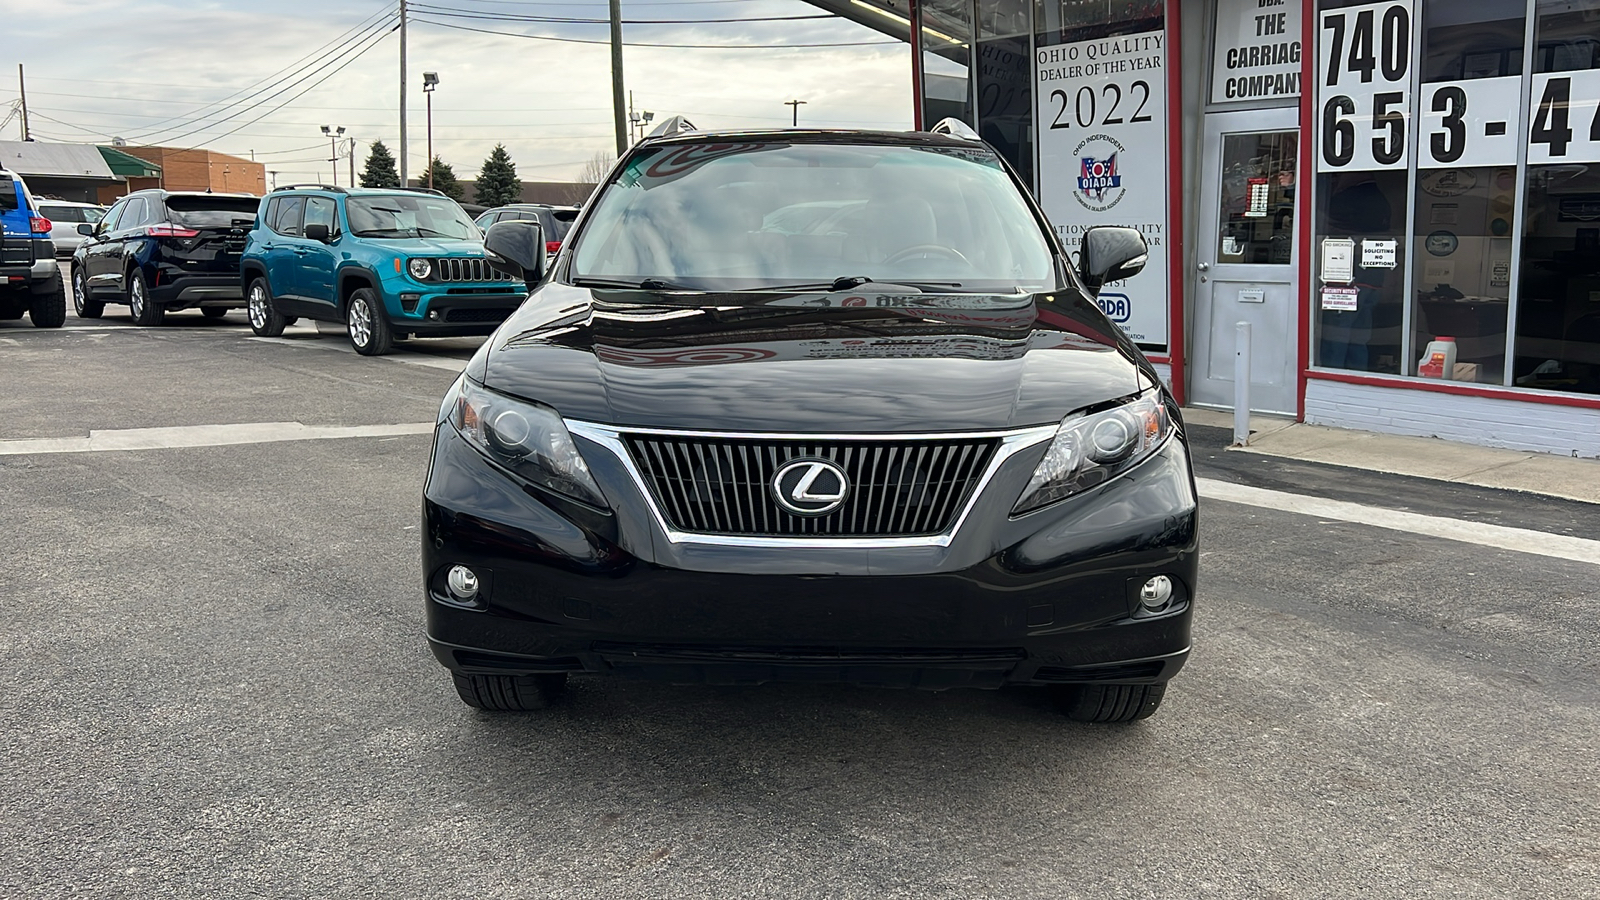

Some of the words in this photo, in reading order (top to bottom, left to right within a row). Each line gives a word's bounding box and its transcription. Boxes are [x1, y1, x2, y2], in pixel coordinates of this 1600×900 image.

[1255, 12, 1286, 36] THE
[1038, 46, 1079, 64] OHIO
[1086, 35, 1163, 60] QUALITY
[1324, 5, 1409, 87] 740
[1040, 65, 1083, 82] DEALER
[1085, 63, 1100, 76] OF
[1102, 60, 1127, 74] THE
[1129, 55, 1161, 71] YEAR
[1050, 80, 1152, 129] 2022
[1072, 140, 1086, 156] OHIO
[1085, 133, 1126, 153] INDEPENDENT
[1082, 176, 1114, 189] OIADA
